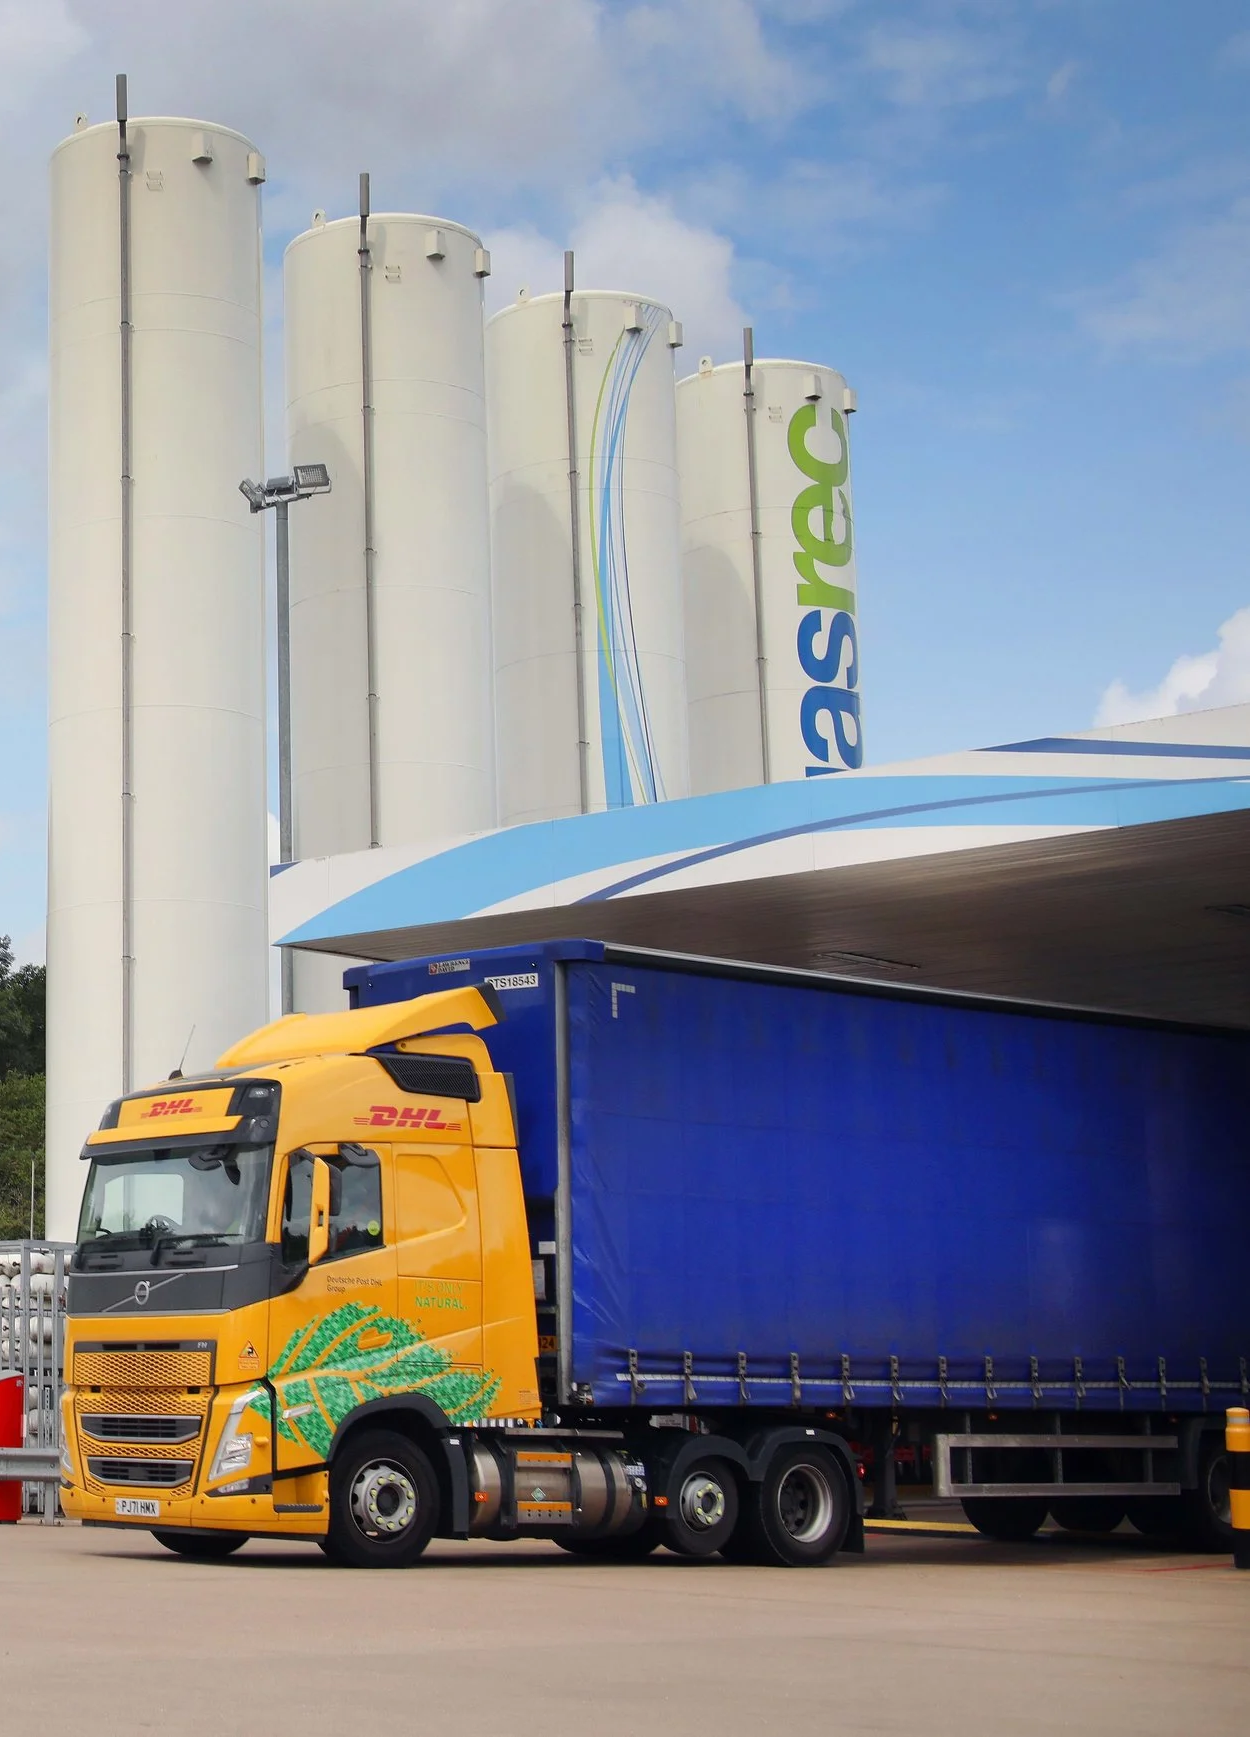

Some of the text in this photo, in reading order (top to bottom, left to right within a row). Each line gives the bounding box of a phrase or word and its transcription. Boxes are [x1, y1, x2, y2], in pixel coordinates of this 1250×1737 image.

[150, 1098, 194, 1118] DHL
[369, 1105, 449, 1130] DHL
[327, 1275, 355, 1285] Deutsche
[356, 1277, 370, 1286] Post
[414, 1279, 464, 1294] IT'S ONLY
[326, 1284, 346, 1294] Group
[121, 1500, 139, 1514] PJ71
